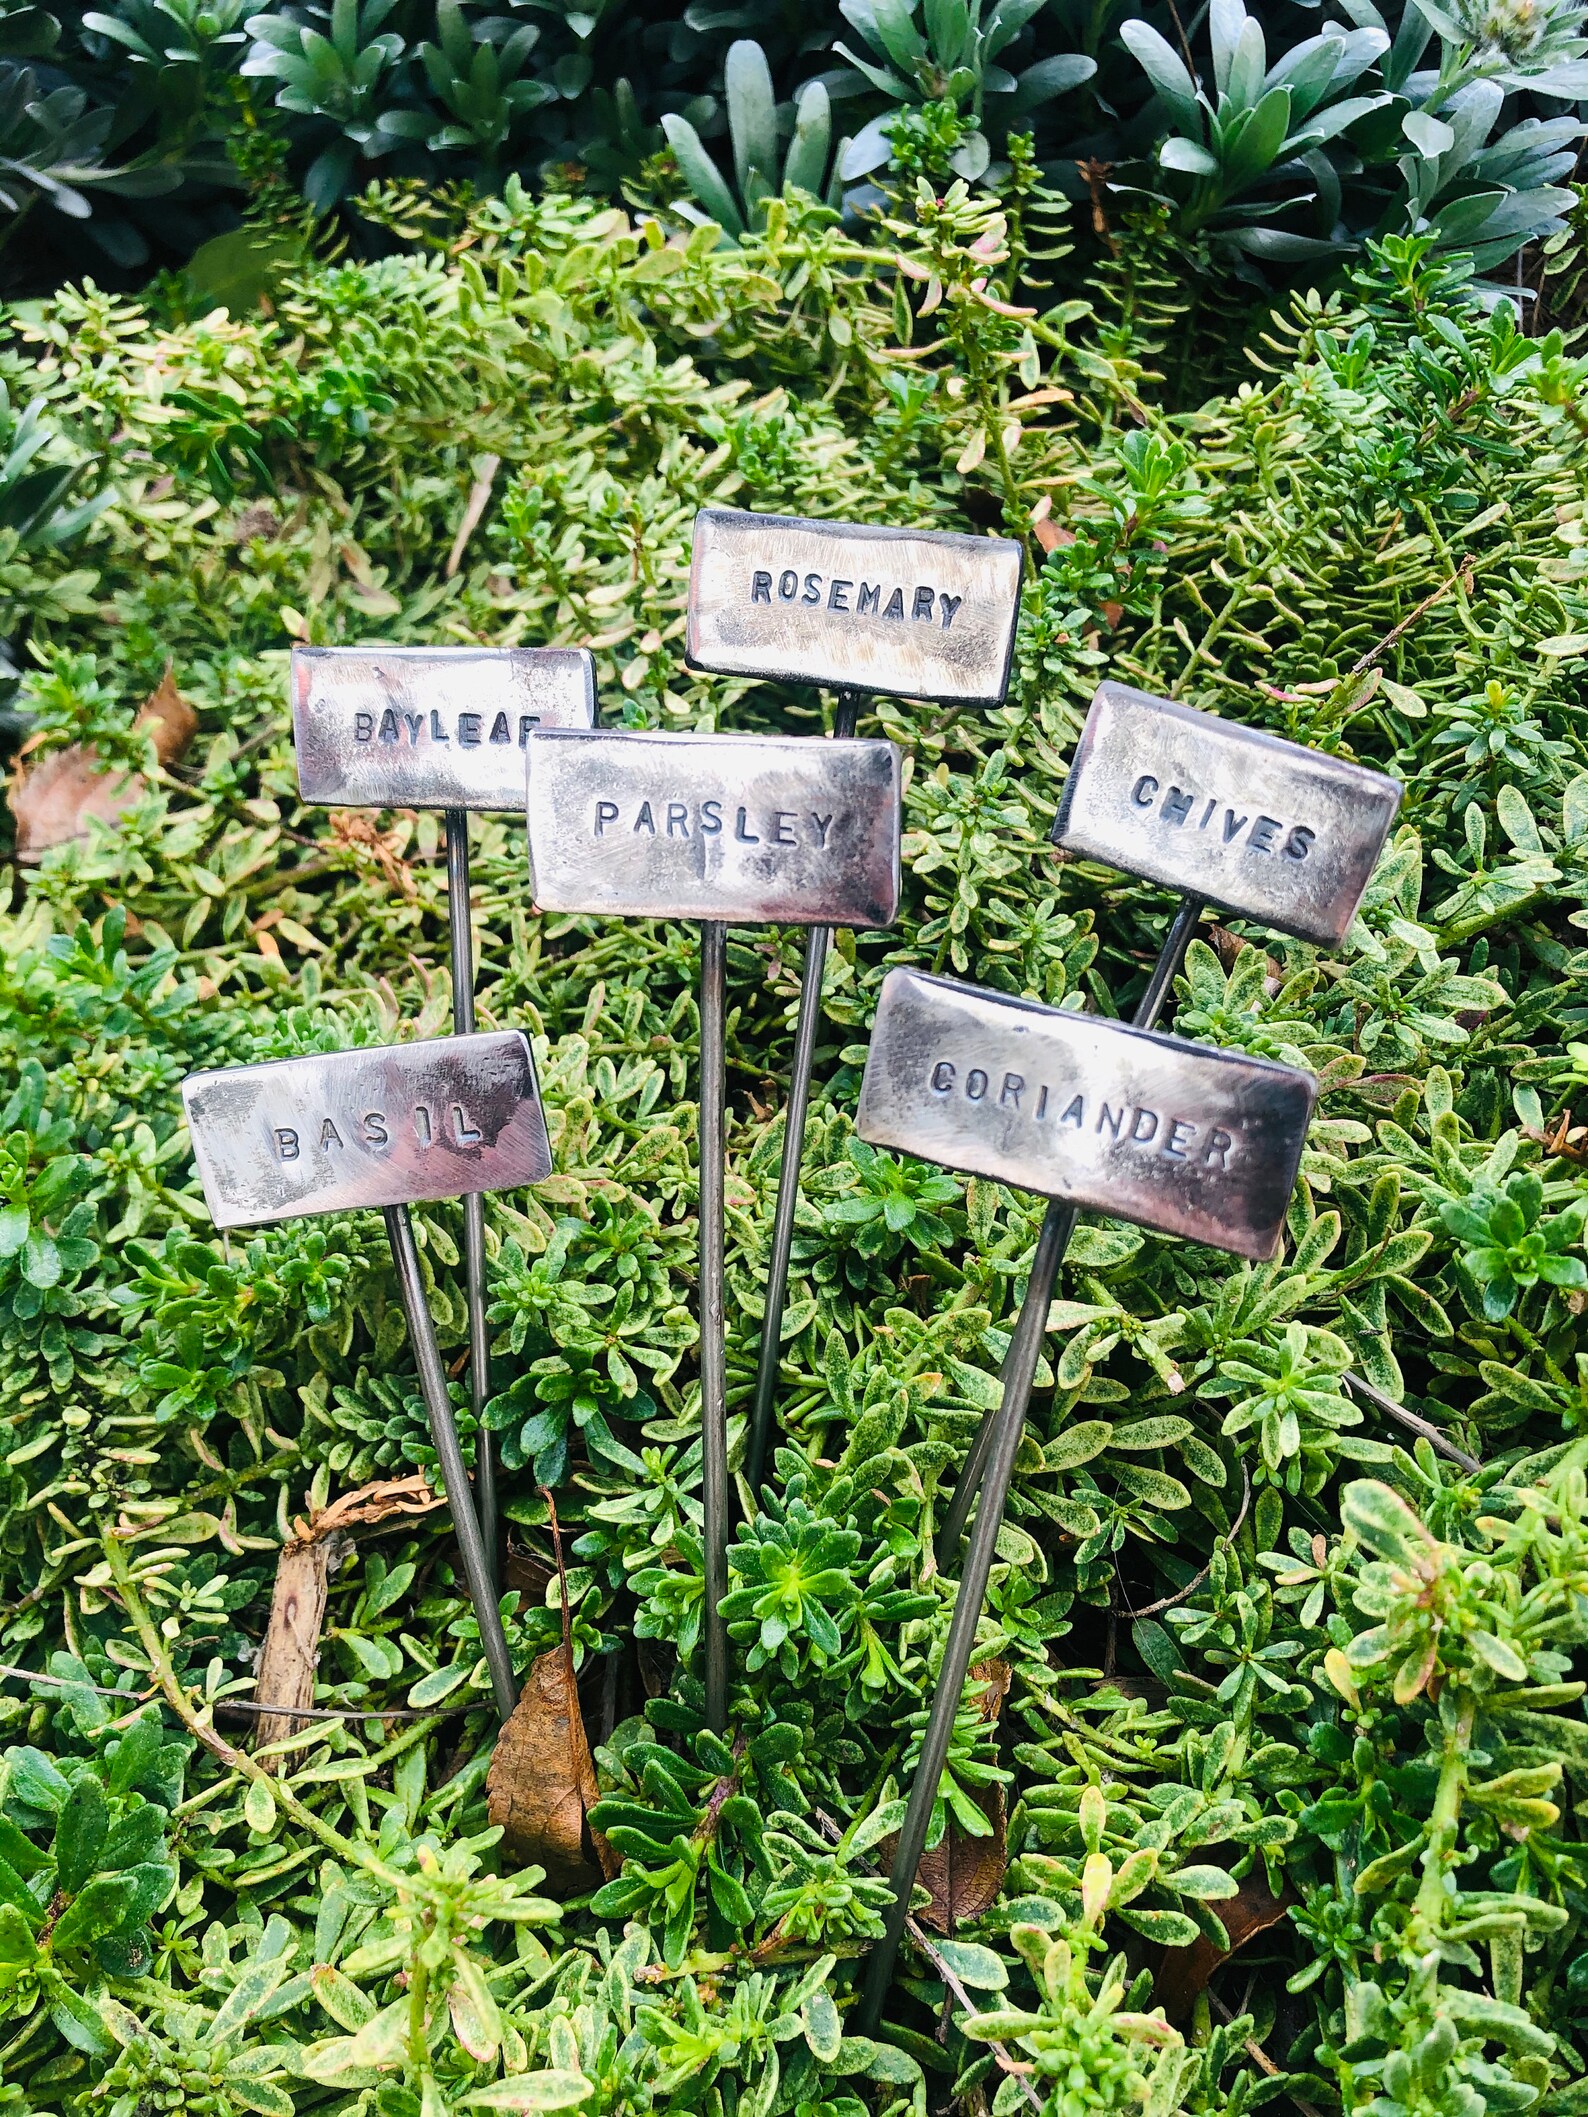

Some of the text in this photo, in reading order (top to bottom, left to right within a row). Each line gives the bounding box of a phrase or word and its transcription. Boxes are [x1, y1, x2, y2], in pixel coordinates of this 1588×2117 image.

[752, 570, 962, 629] ROSEMARY
[354, 709, 541, 750] BAYLEAF
[594, 801, 834, 848] PARSLEY
[1130, 775, 1316, 860] CHIVES
[274, 1106, 481, 1162] BASIL
[930, 1062, 1234, 1172] CORIANDER
